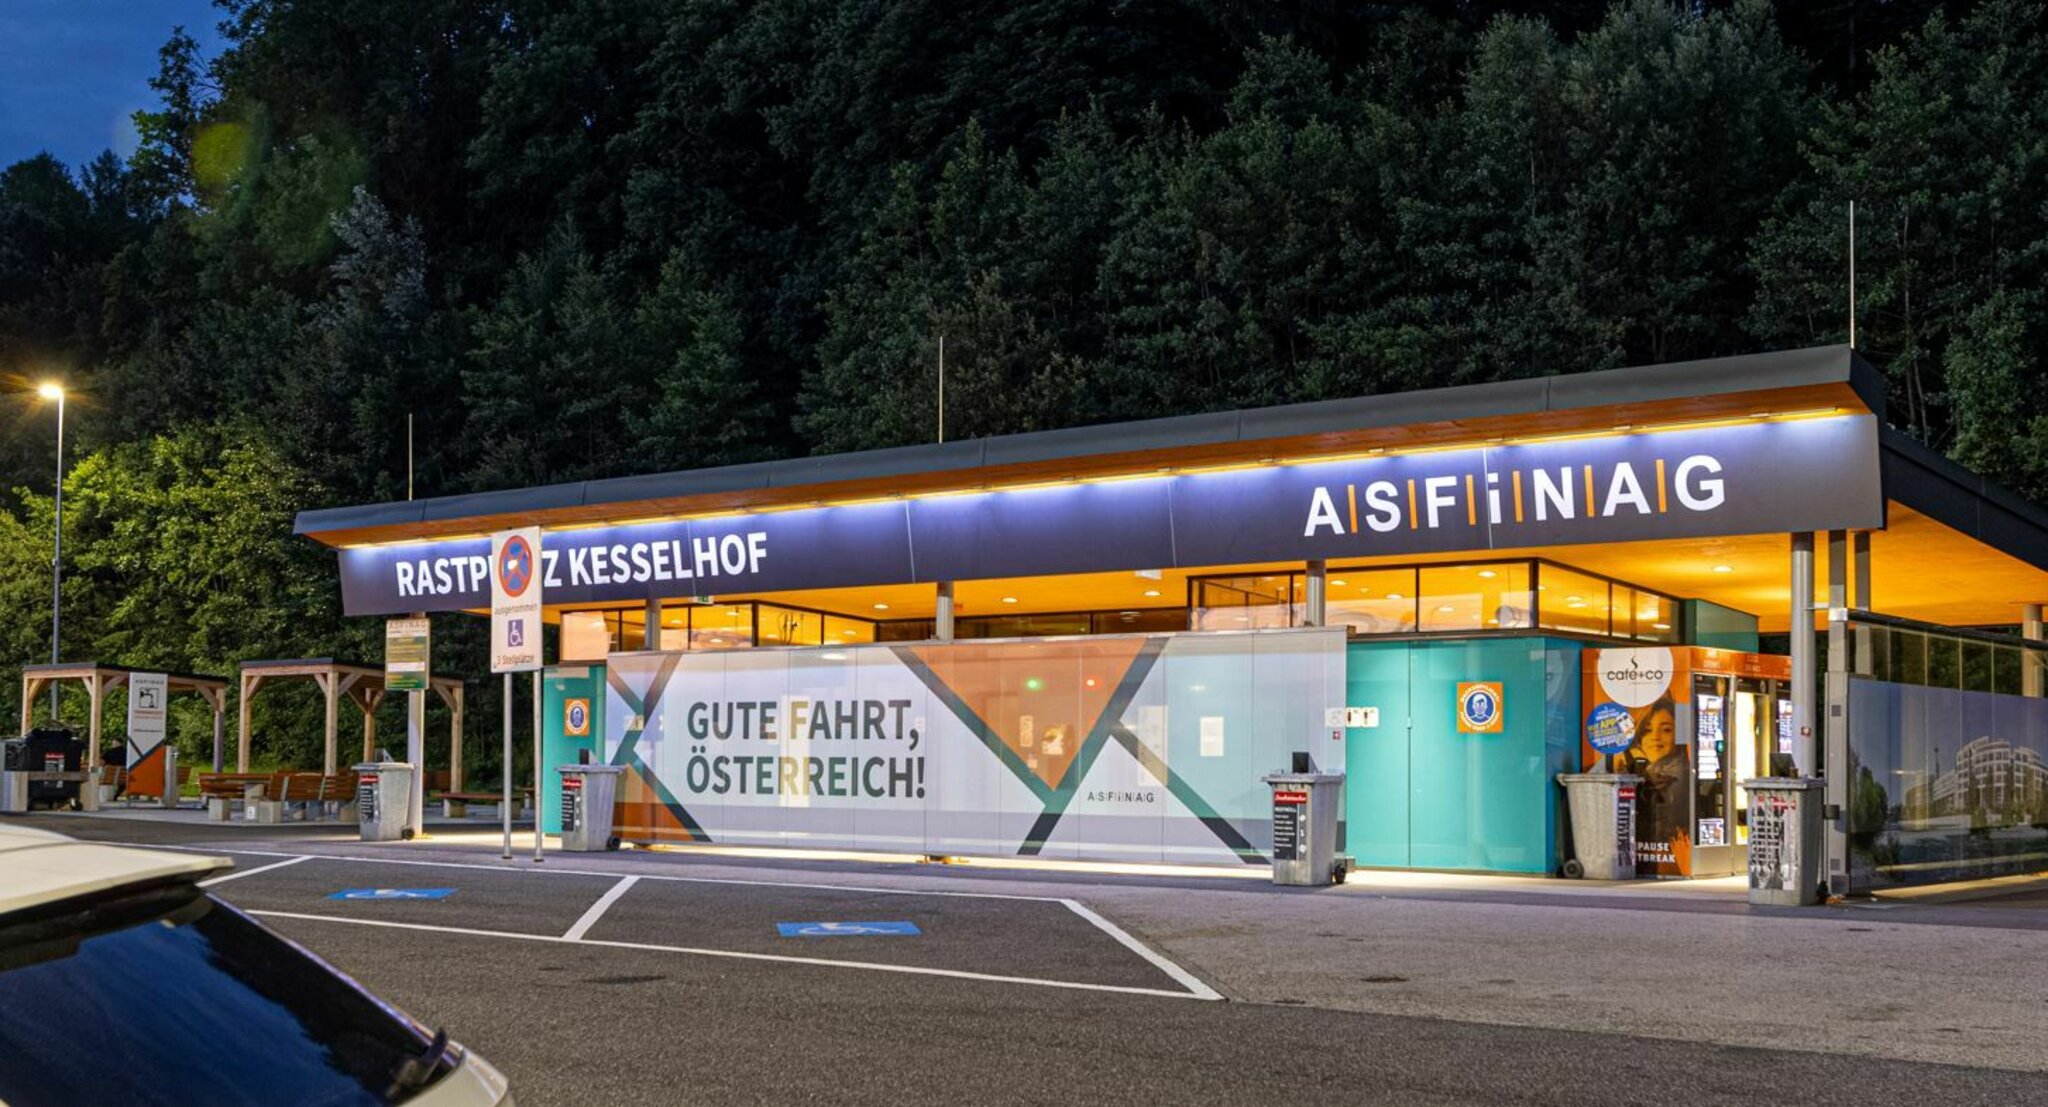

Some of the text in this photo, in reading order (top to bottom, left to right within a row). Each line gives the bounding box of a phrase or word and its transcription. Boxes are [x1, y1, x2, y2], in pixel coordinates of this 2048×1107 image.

[396, 532, 767, 597] RASTPZ KESSELHOF
[687, 699, 919, 751] GUTE FAHRT,
[686, 745, 925, 799] ÖSTERREICH!
[1637, 842, 1670, 851] PAUSE
